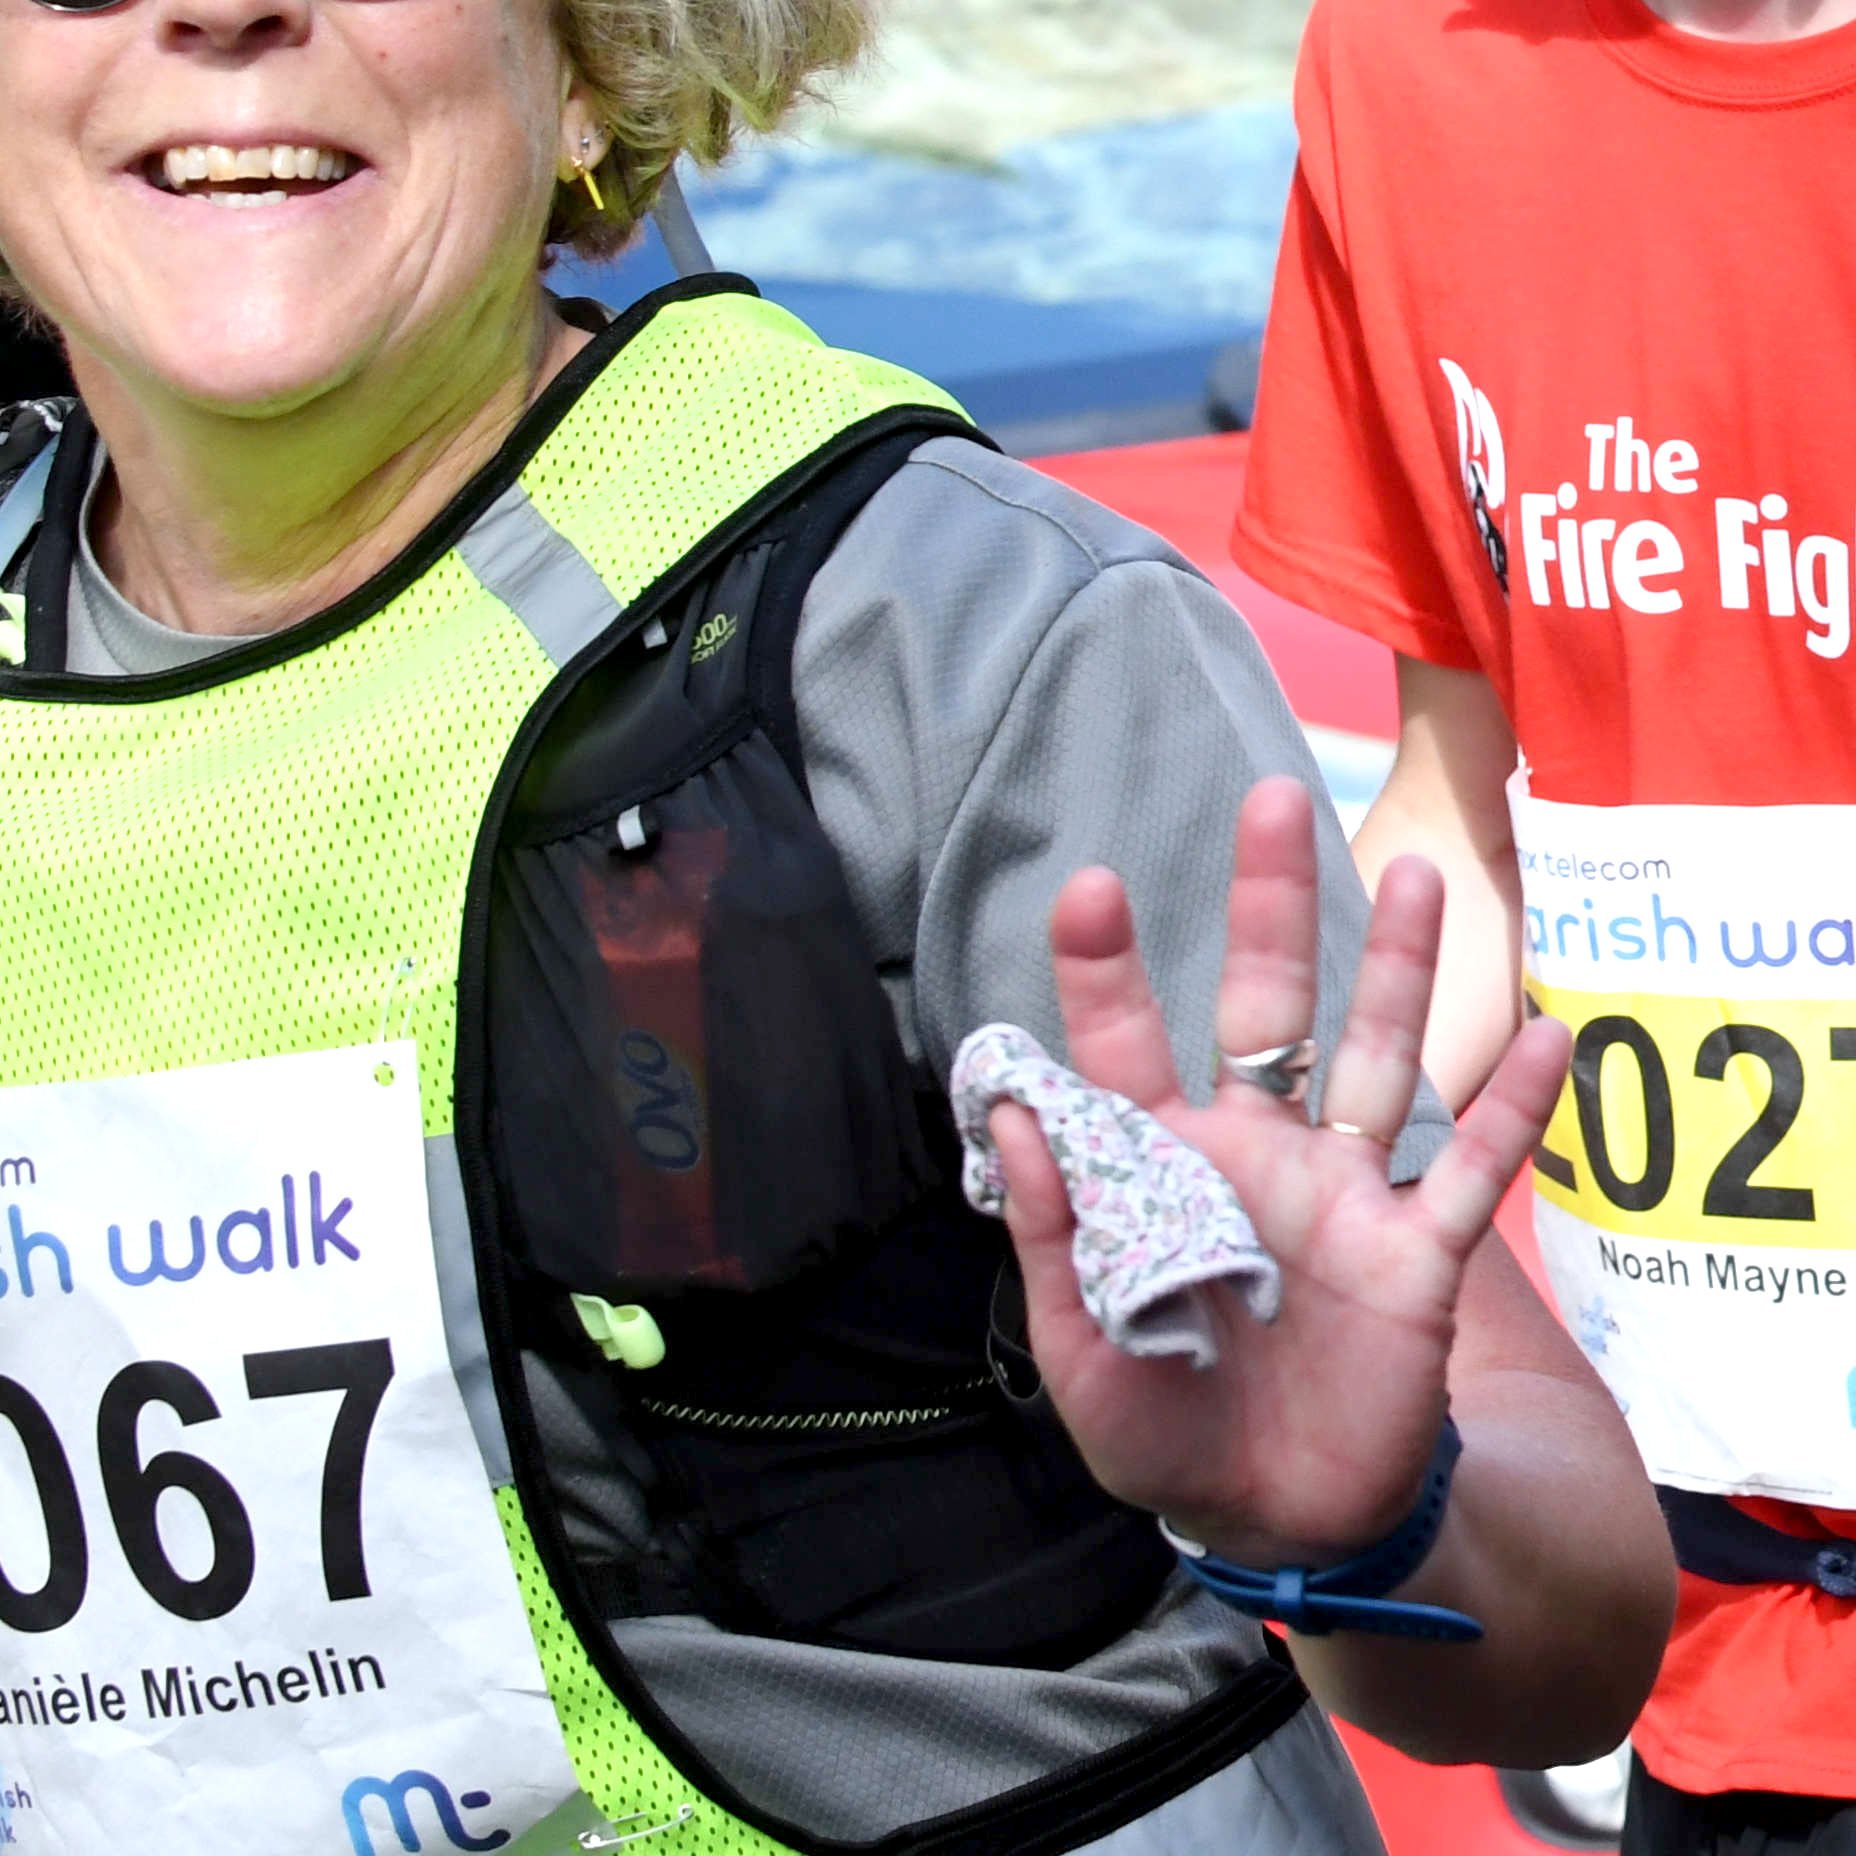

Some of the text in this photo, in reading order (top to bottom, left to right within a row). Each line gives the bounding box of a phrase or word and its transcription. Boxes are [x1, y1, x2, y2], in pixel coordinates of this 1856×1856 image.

[1585, 416, 1699, 494] The
[1520, 482, 1683, 613] Fire
[1544, 850, 1671, 881] telecom
[0, 1170, 361, 1297] h walk
[1599, 1236, 1848, 1304] Noah Mayne
[0, 1336, 395, 1633] 067
[141, 1647, 386, 1719] Michelin
